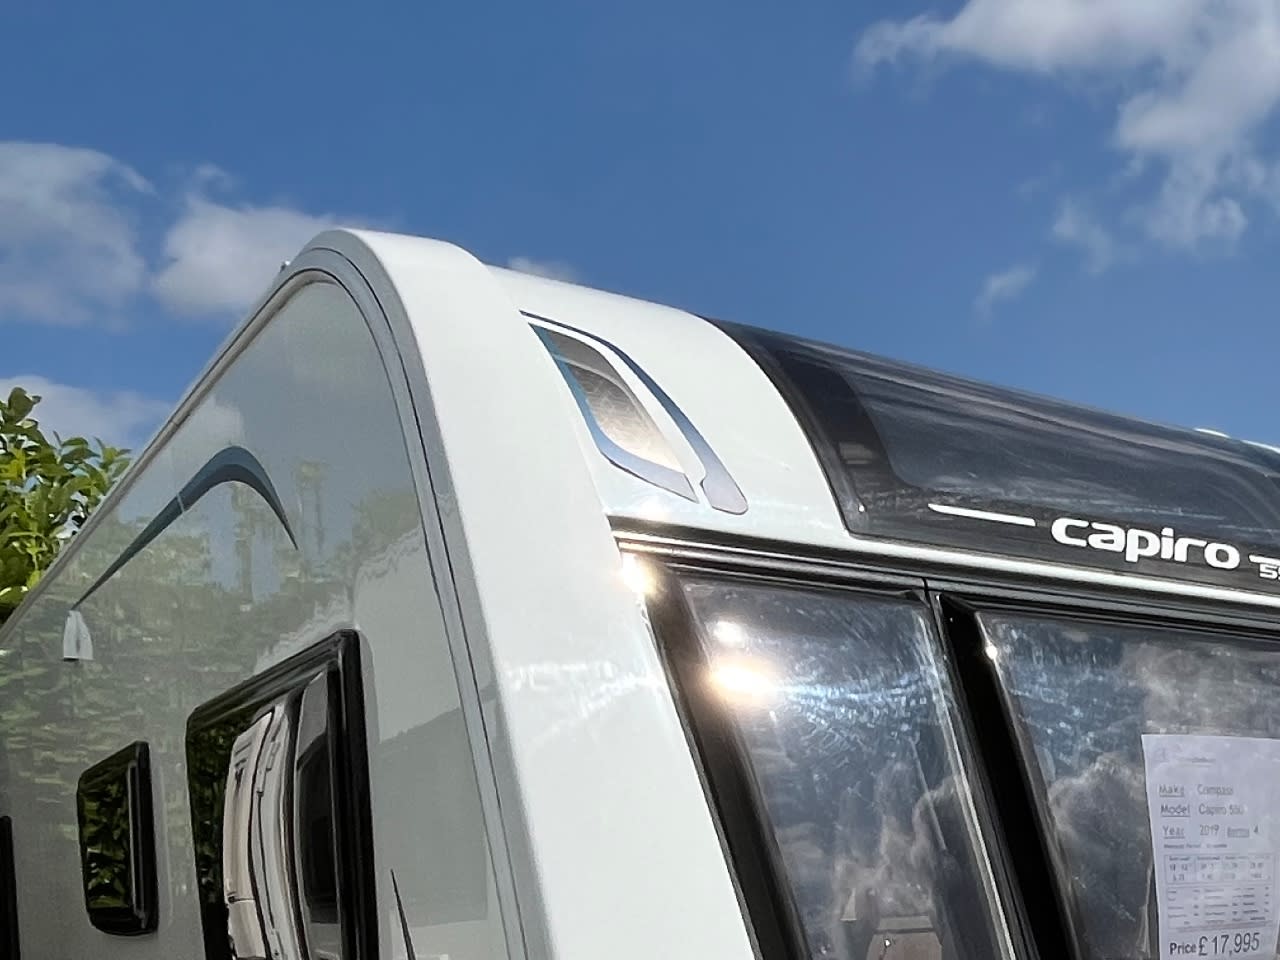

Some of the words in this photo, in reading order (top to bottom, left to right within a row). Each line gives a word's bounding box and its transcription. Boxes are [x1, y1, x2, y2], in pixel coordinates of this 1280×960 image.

[1051, 517, 1240, 569] capiro
[1161, 804, 1190, 816] Model
[1200, 824, 1220, 836] 2019
[1169, 941, 1196, 955] Price
[1198, 931, 1261, 957] £17,995
